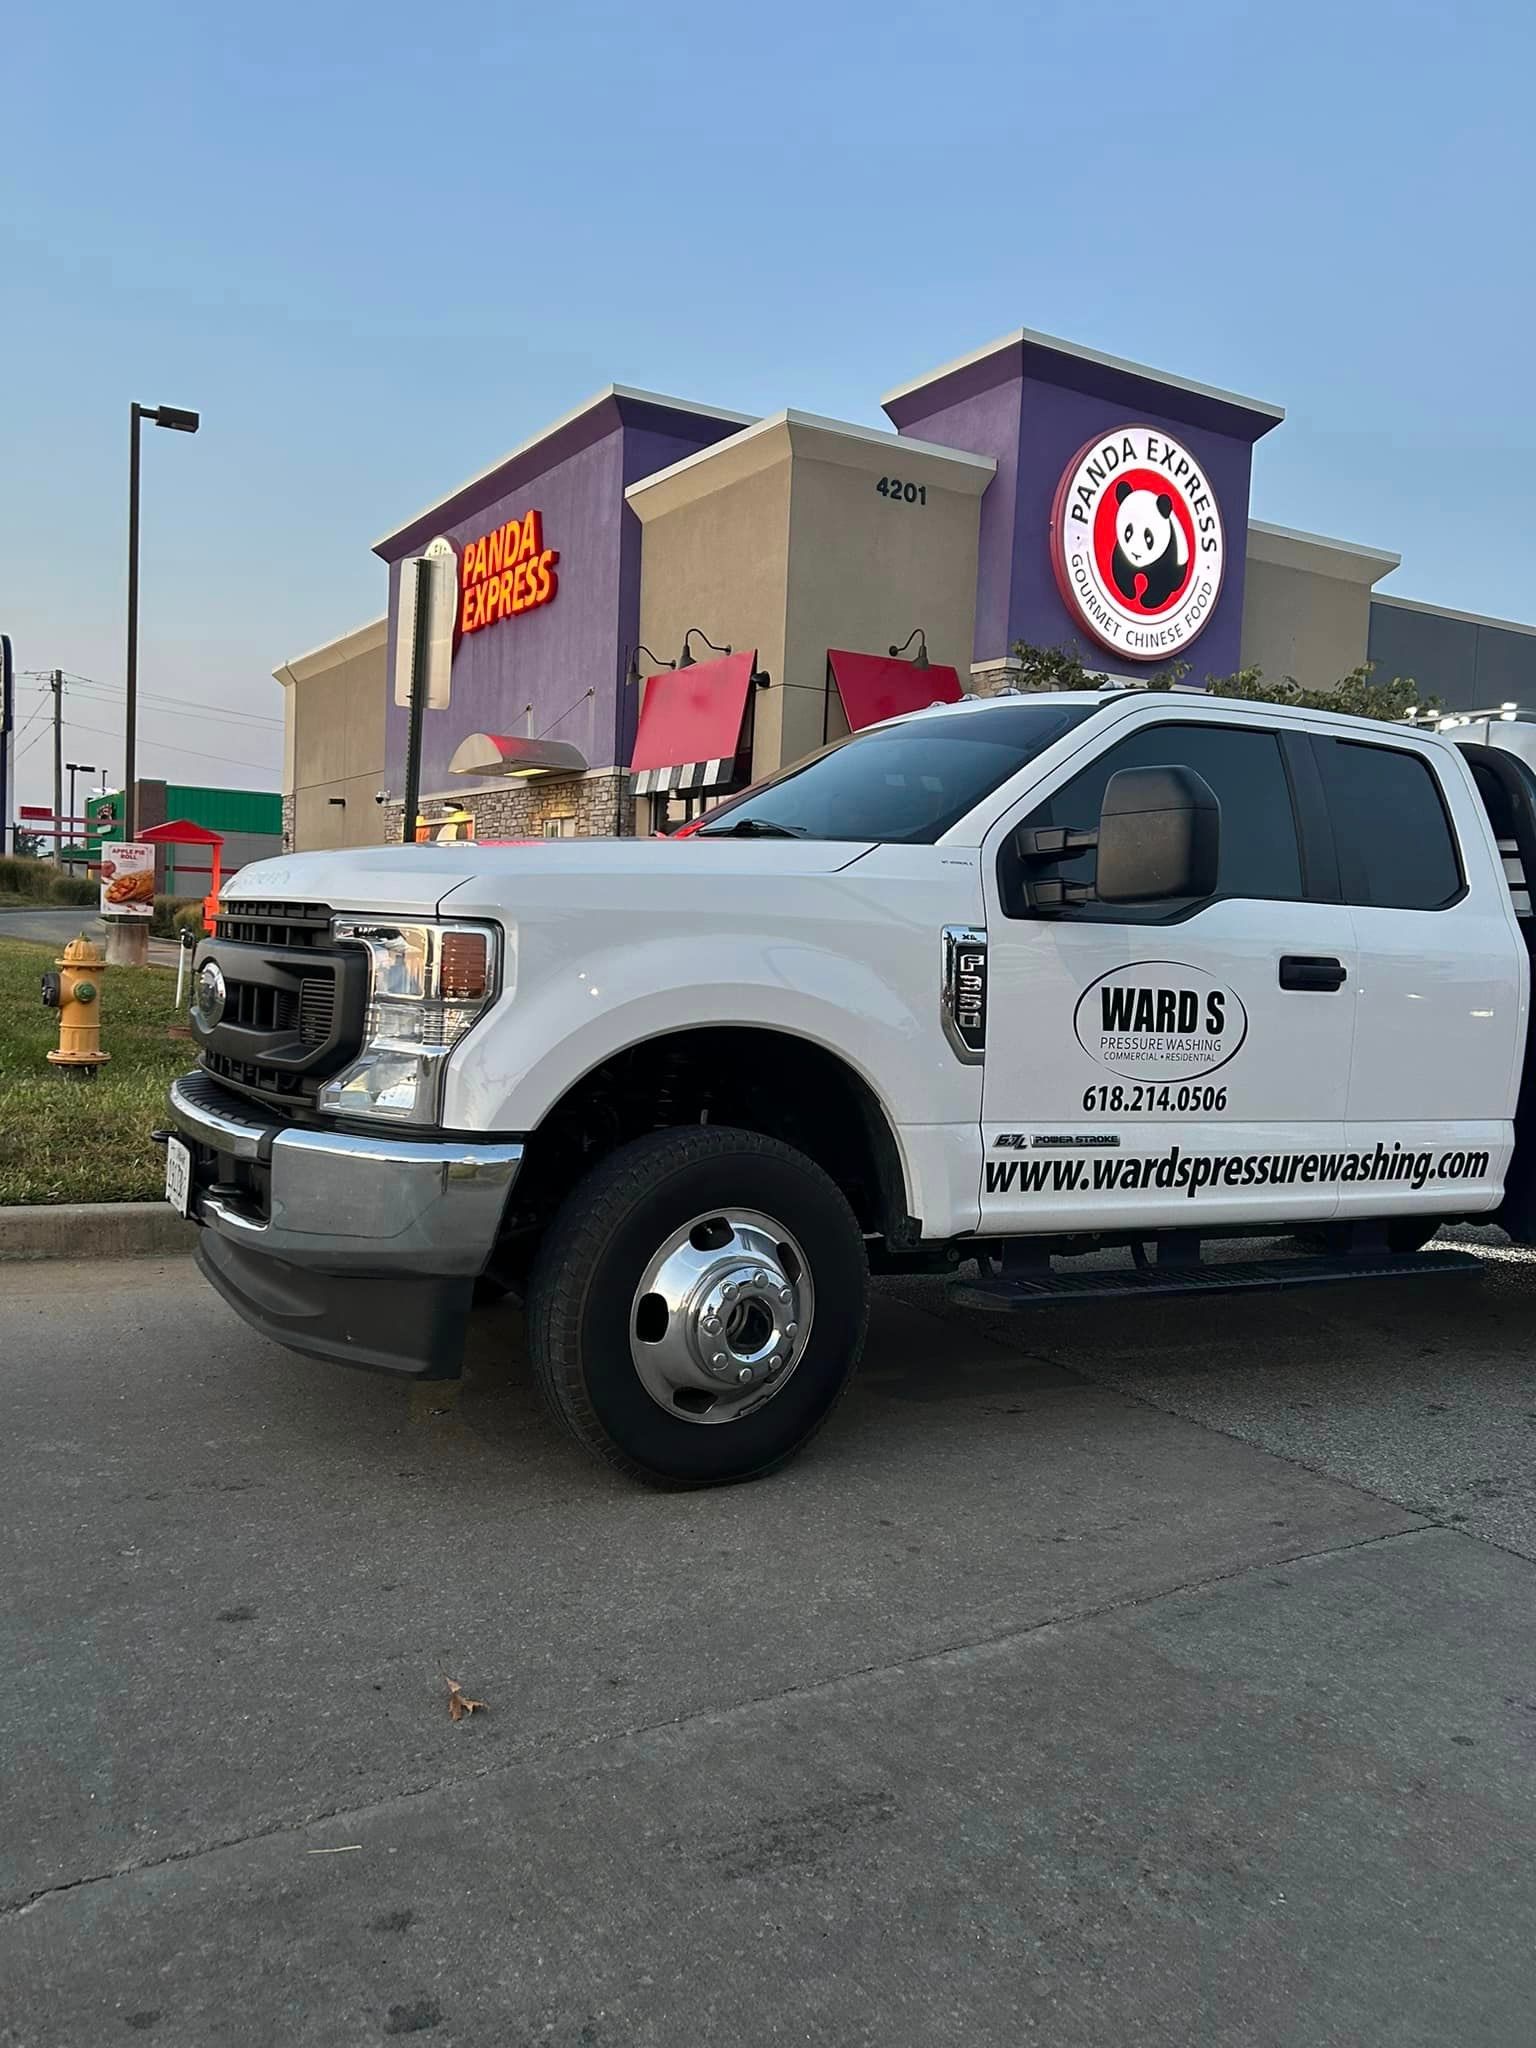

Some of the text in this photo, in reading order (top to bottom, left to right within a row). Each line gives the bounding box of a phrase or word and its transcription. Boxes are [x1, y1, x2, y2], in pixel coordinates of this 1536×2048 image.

[876, 477, 926, 505] 4201
[1071, 436, 1218, 554] PANDA EXPRESS
[462, 509, 537, 589] PANDA
[461, 549, 553, 632] EXPRESS
[1071, 553, 1213, 649] GOURMET CHINESE FOOD
[1101, 987, 1199, 1034] WARD
[1100, 1036, 1222, 1052] PRESSURE WASHING
[1103, 1051, 1216, 1062] COMMERCIAL RESIDENTIAL
[1082, 1085, 1228, 1112] 618.214.0506
[1034, 1135, 1074, 1145] POWER
[1075, 1135, 1119, 1144] STROKE
[984, 1142, 1490, 1198] www.wardspressurewashing.com
